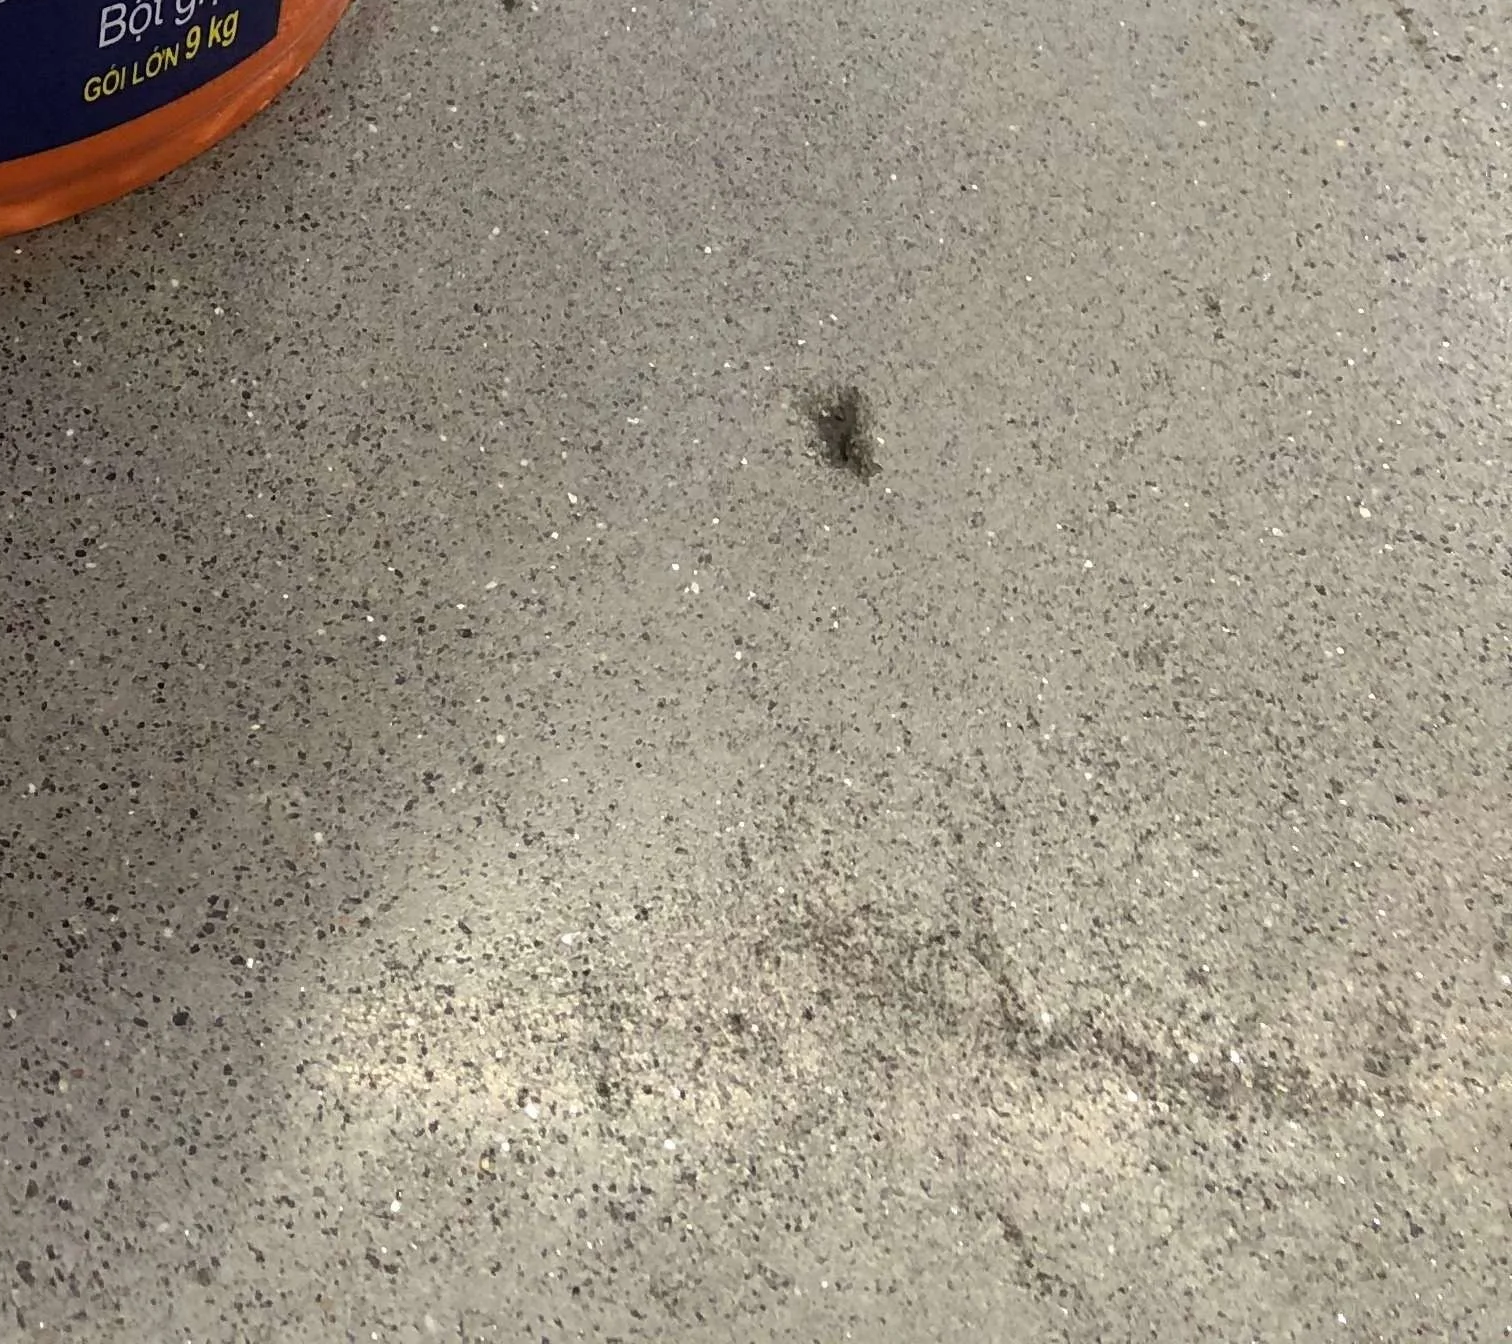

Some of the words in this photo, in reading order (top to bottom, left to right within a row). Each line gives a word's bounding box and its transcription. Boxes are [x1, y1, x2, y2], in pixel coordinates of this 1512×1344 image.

[83, 64, 126, 104] GÓI
[132, 40, 181, 85] LỚN
[185, 24, 202, 61] 9
[207, 8, 240, 49] kg
